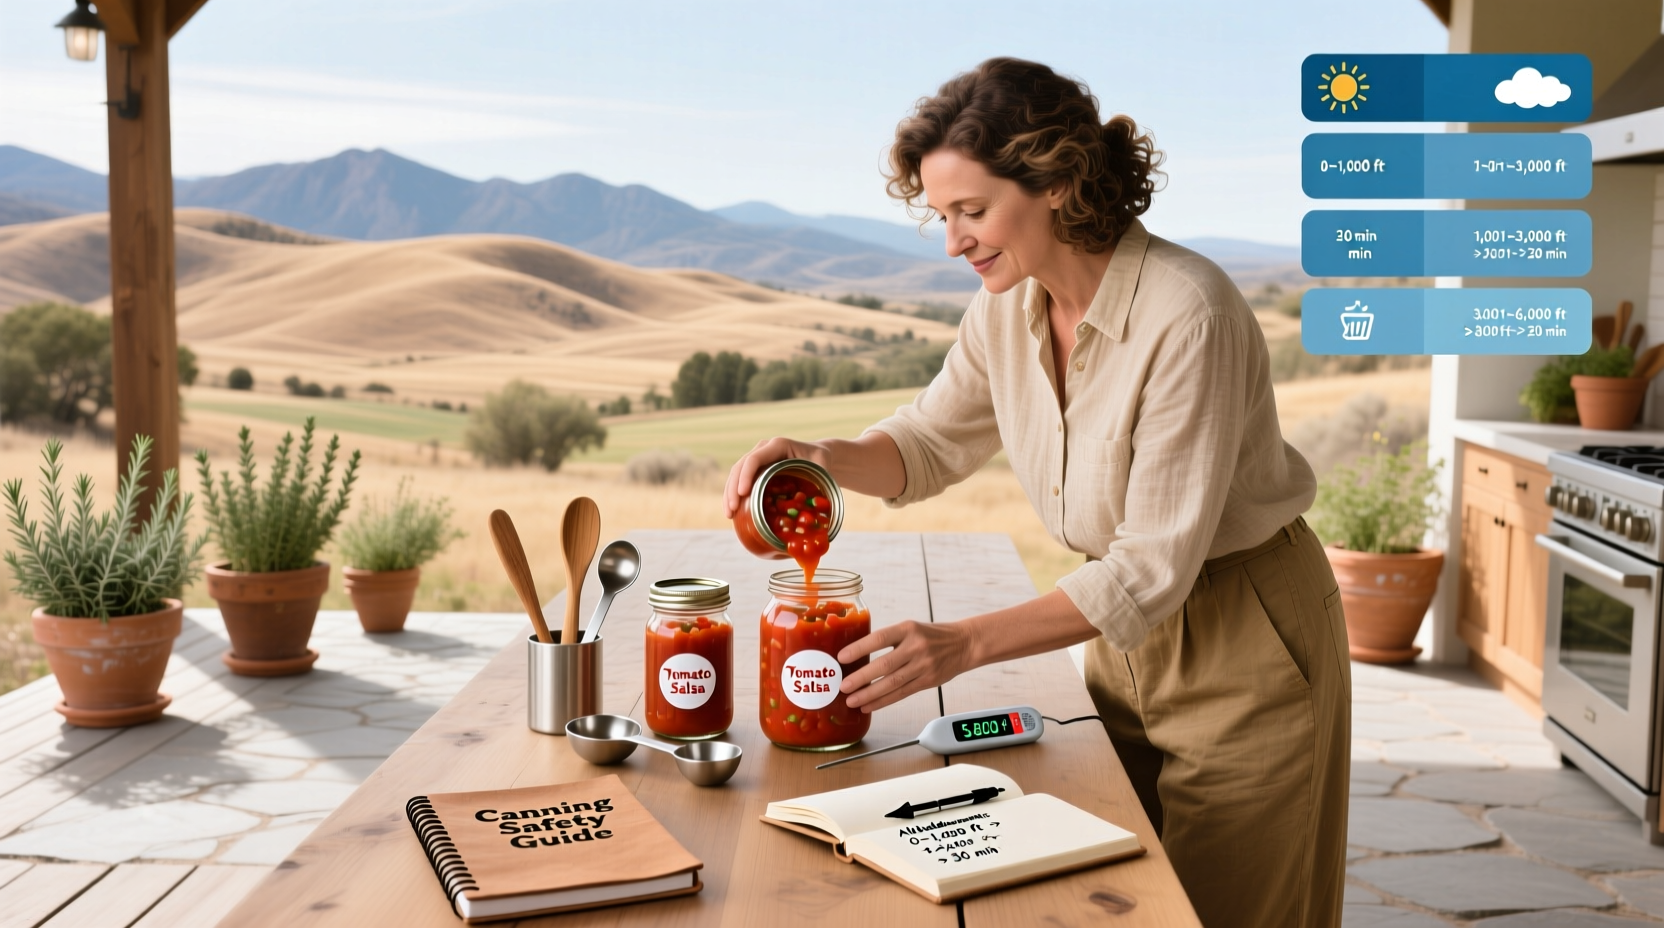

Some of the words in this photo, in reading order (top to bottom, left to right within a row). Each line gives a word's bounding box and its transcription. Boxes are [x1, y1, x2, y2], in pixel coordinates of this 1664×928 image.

[663, 667, 712, 681] Tomato
[785, 665, 836, 679] Tomato
[670, 681, 706, 694] Salsa
[793, 680, 831, 693] Salsa
[474, 798, 614, 823] Canning
[498, 814, 606, 835] Safety
[510, 828, 614, 849] Guide
